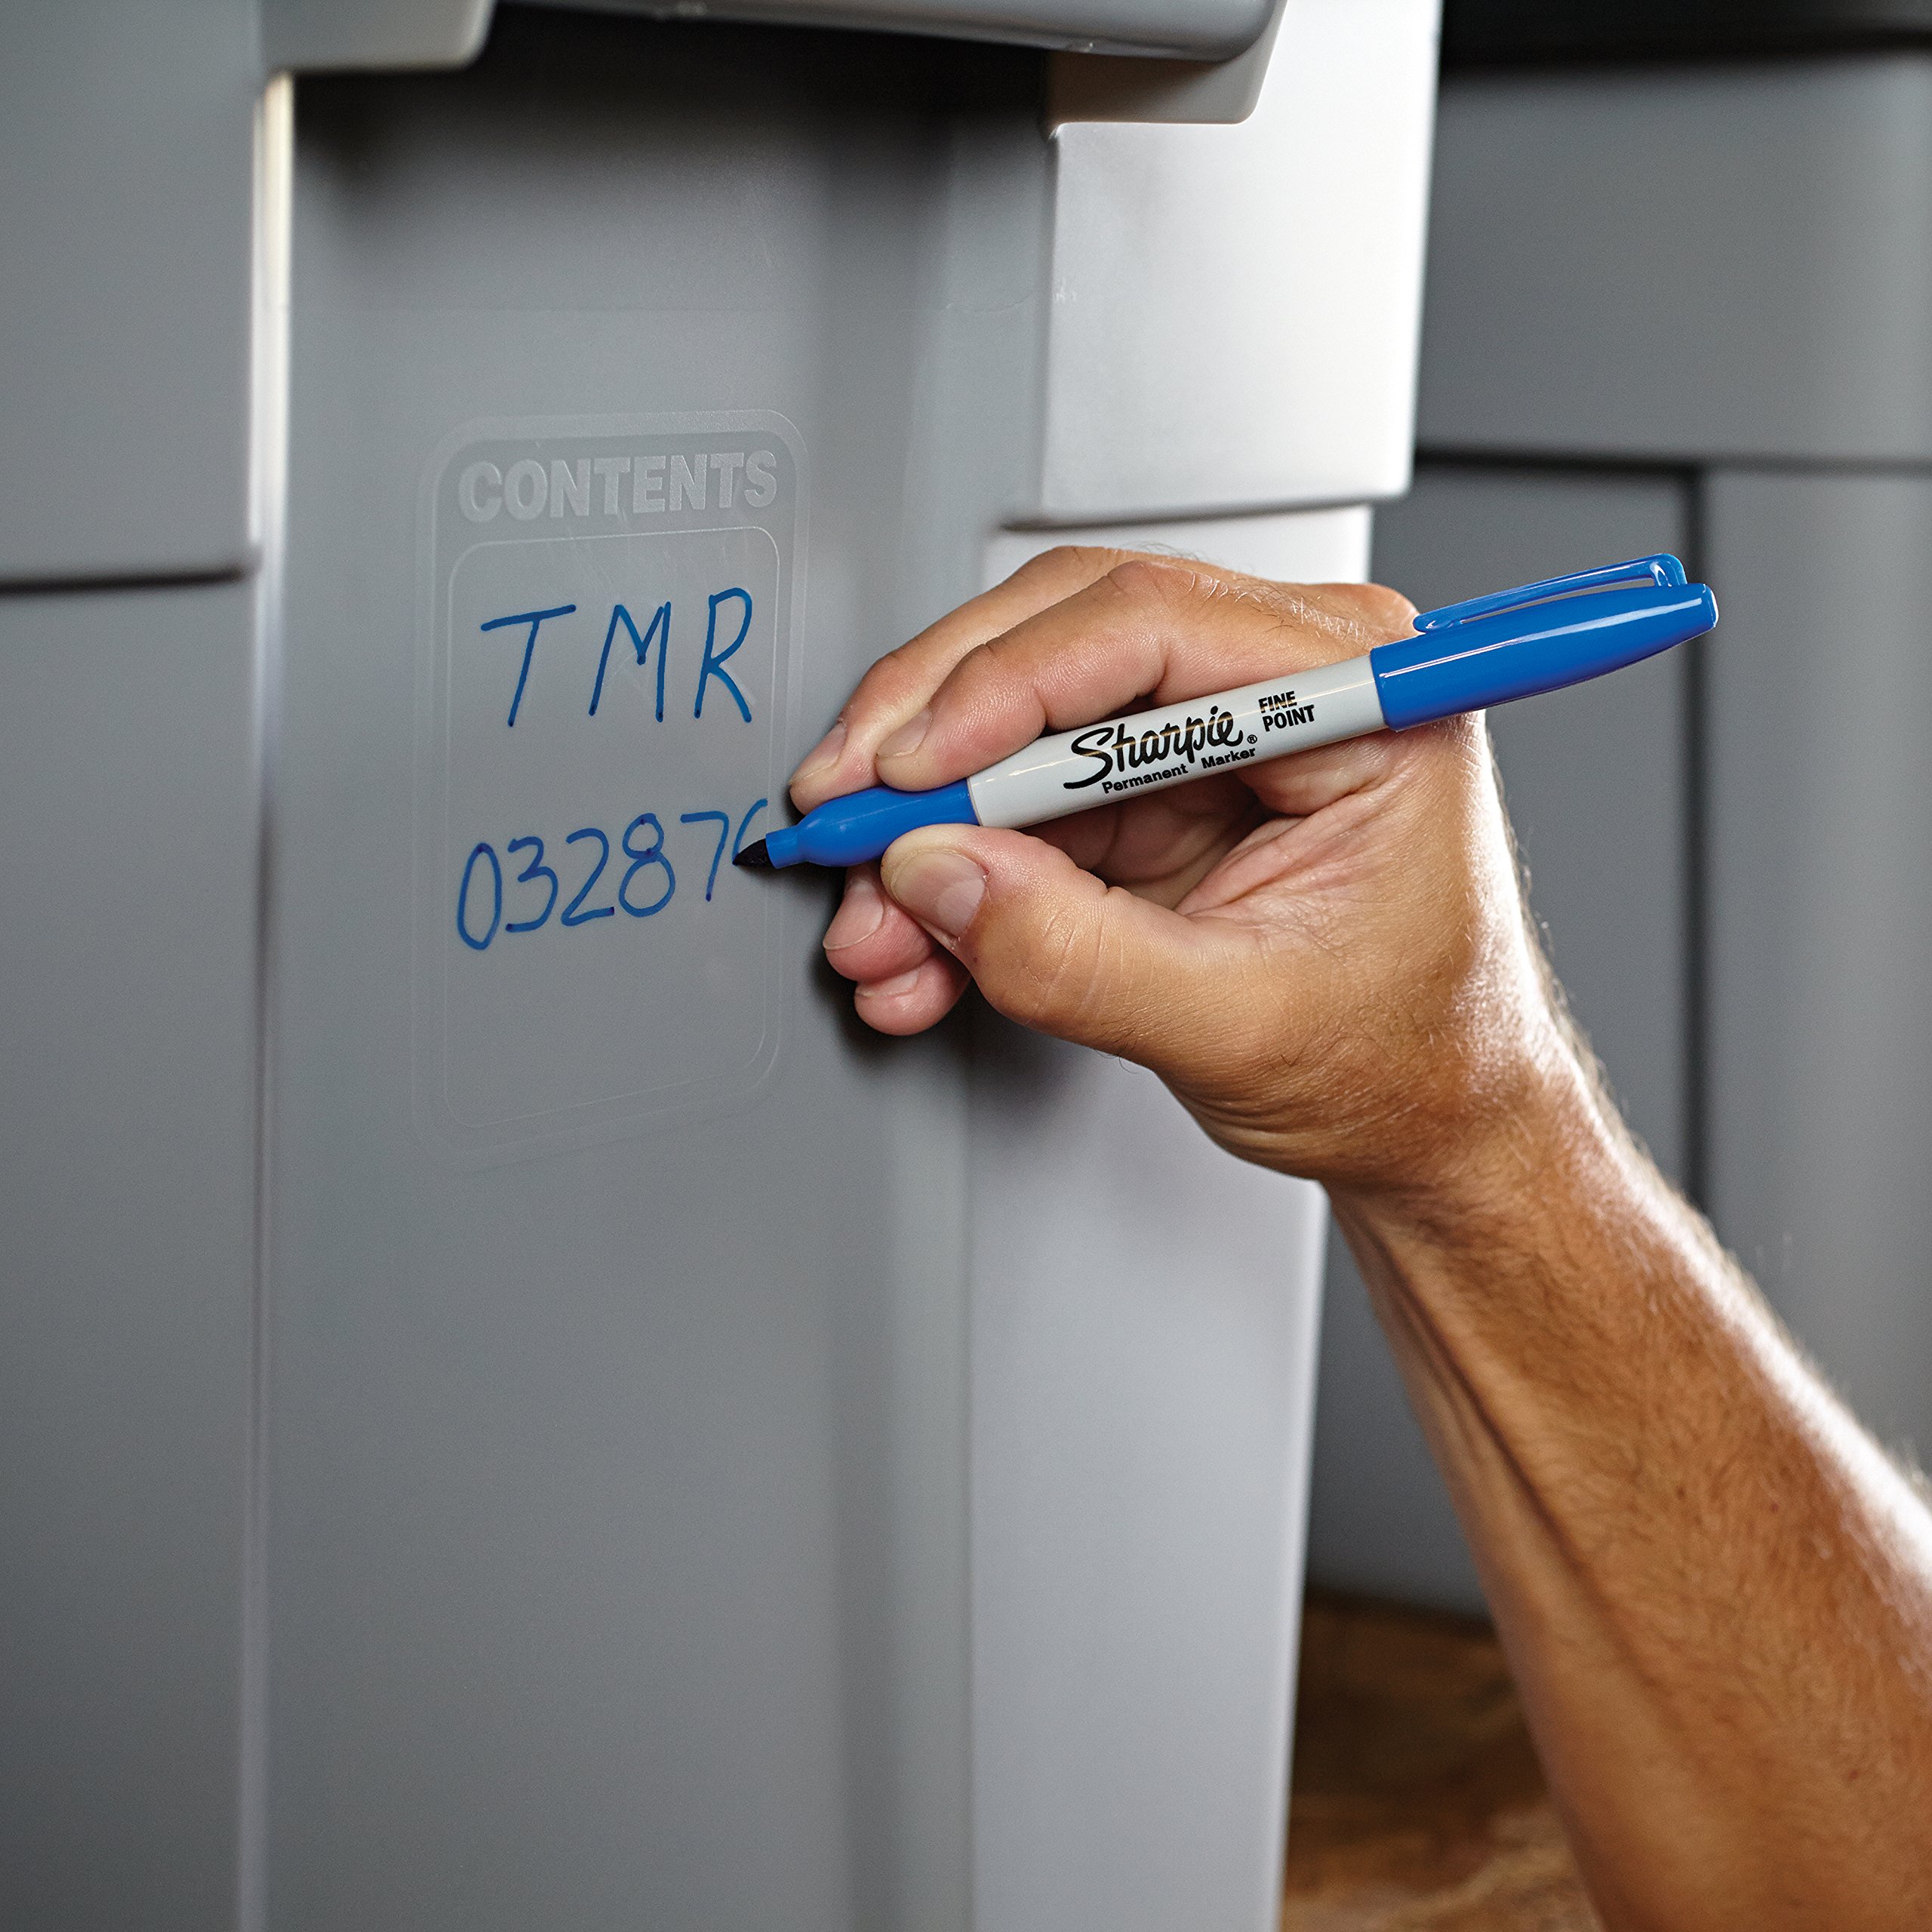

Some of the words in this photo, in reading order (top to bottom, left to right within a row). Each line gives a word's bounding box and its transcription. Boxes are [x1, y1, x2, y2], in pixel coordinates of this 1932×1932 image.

[457, 450, 777, 523] CONTENTS
[480, 586, 753, 728] TMR
[1258, 691, 1297, 714] FINE
[1262, 704, 1315, 732] POINT
[1102, 763, 1189, 794] Permanent
[1201, 748, 1257, 770] Marker
